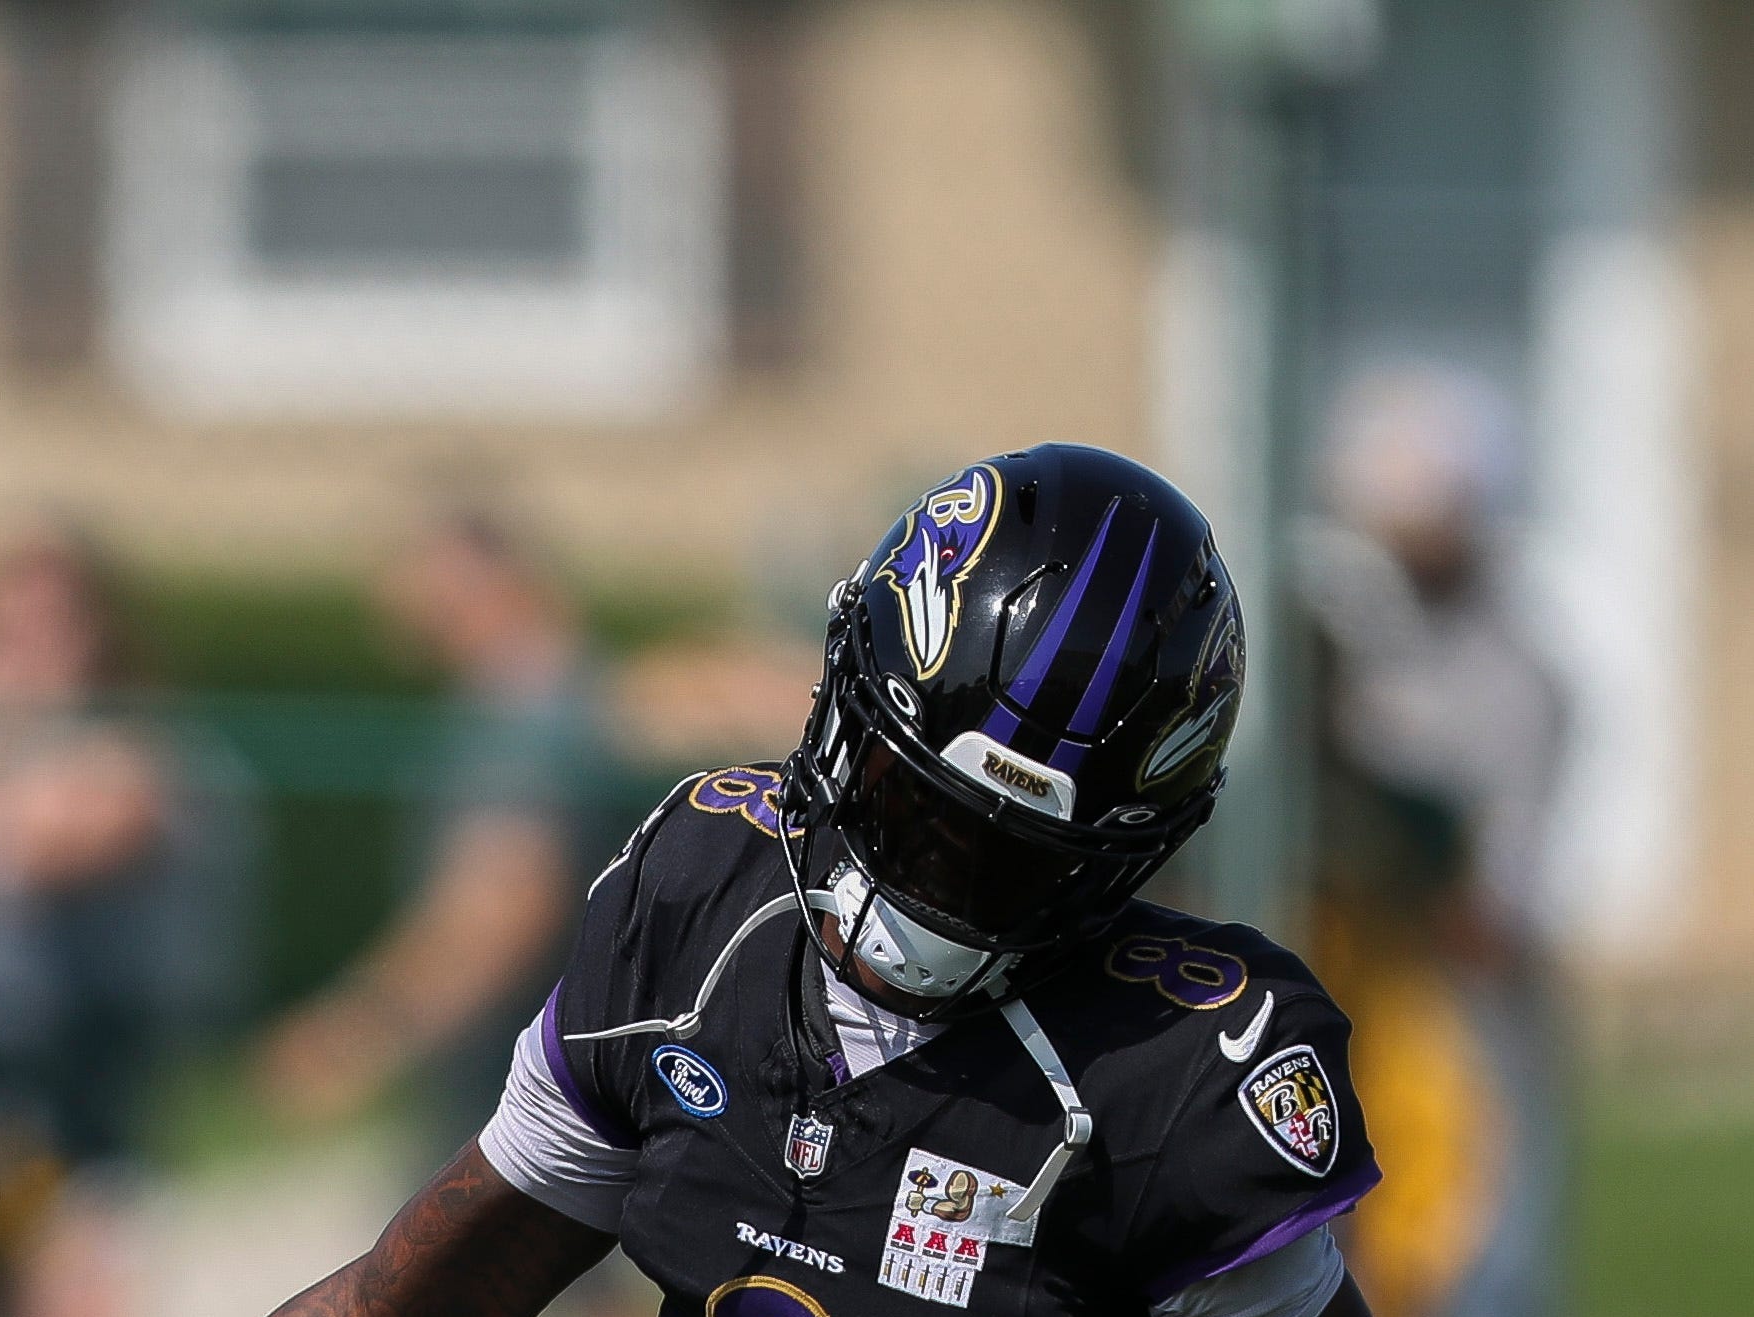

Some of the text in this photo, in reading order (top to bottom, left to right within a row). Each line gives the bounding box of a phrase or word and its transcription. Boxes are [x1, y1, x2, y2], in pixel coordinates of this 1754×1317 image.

[985, 750, 1052, 797] RAVENS
[688, 766, 806, 839] 8
[1104, 935, 1248, 1011] 8
[670, 1058, 711, 1105] Ford
[1249, 1056, 1312, 1099] RAVENS
[1257, 1079, 1299, 1127] B
[791, 1138, 819, 1169] NFL
[736, 1221, 846, 1274] RAVENS
